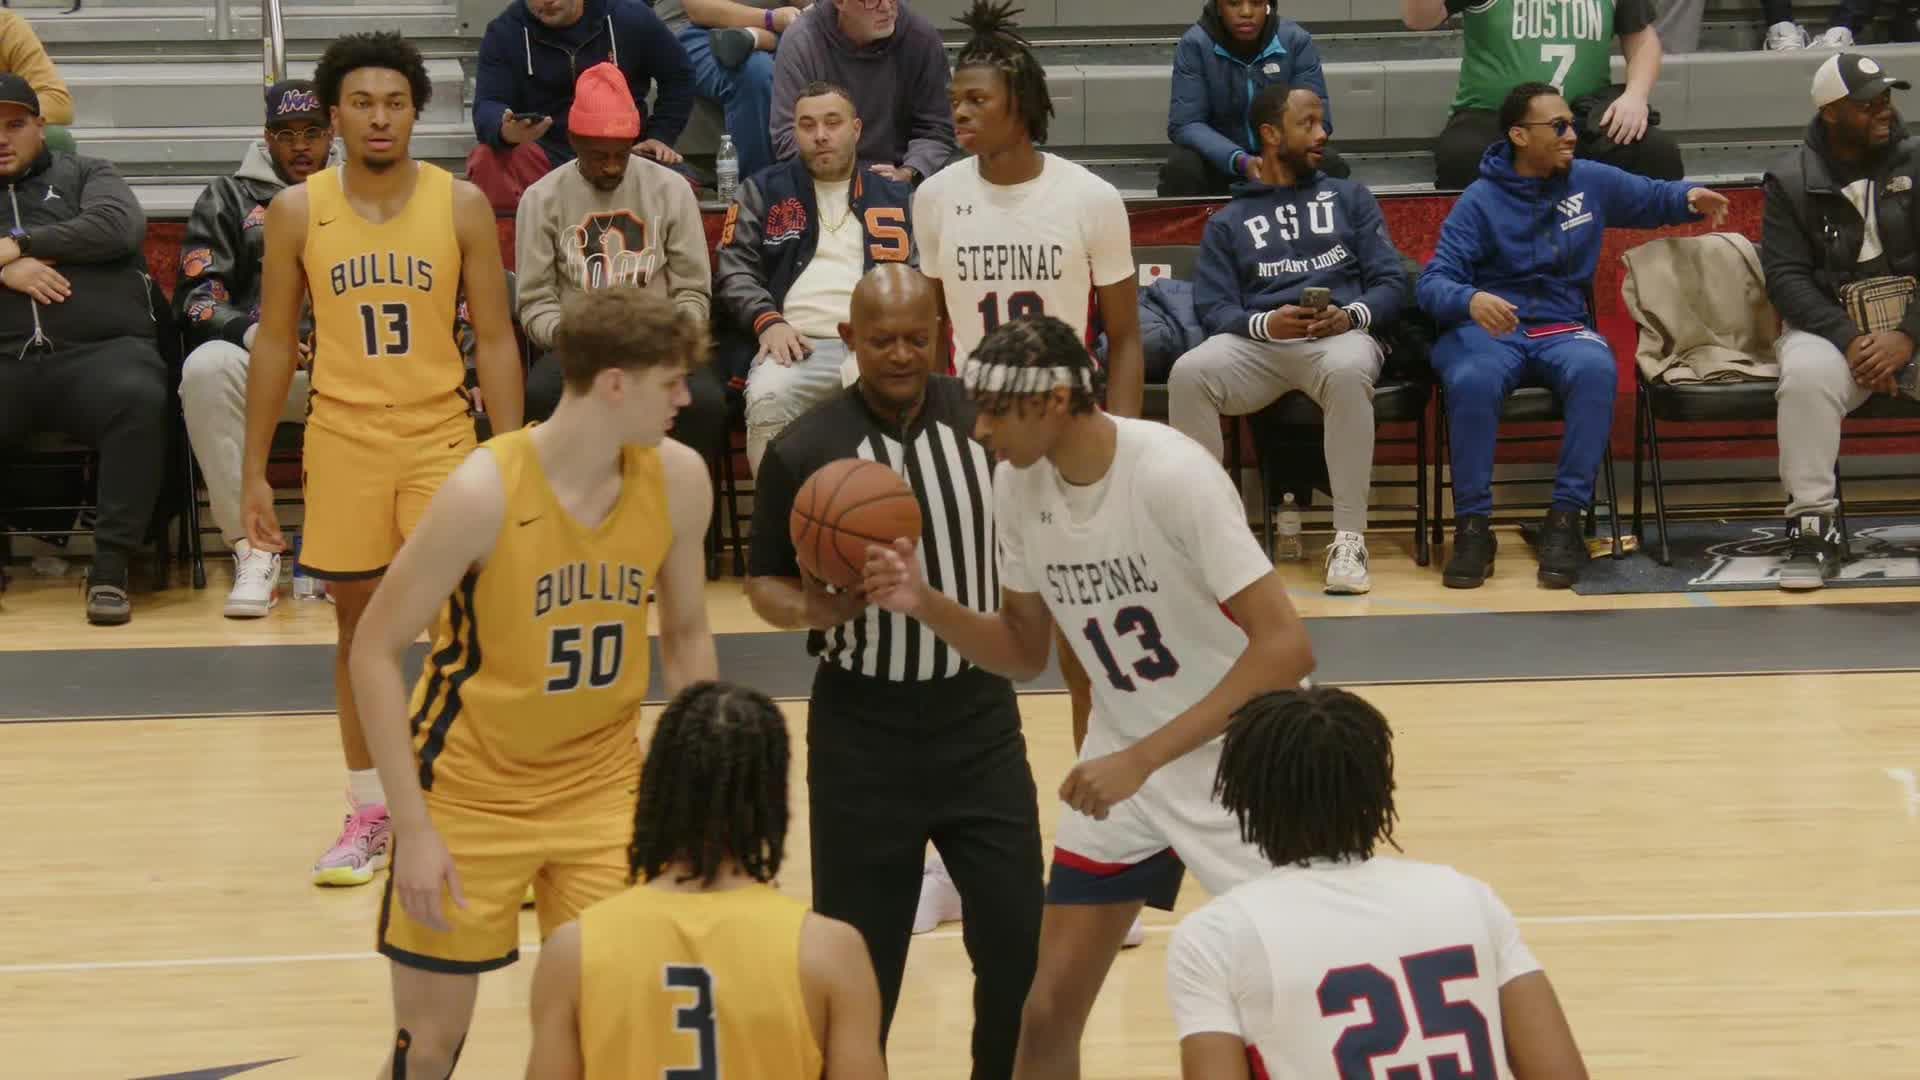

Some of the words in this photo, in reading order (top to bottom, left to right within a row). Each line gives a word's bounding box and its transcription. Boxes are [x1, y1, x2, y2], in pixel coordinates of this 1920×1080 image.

[1511, 0, 1602, 41] BOSTON
[1540, 44, 1576, 96] 7
[863, 207, 910, 262] S
[1243, 201, 1335, 250] PSU
[330, 251, 433, 297] BULLIS
[956, 244, 1063, 281] STEPINAC
[1258, 258, 1309, 277] NITTANY
[1311, 244, 1350, 270] LIONS
[359, 302, 410, 357] 13
[534, 561, 643, 618] BULLIS
[545, 622, 624, 693] 50
[1082, 605, 1180, 692] 13
[662, 963, 720, 1080] 3
[1315, 943, 1499, 1080] 25
